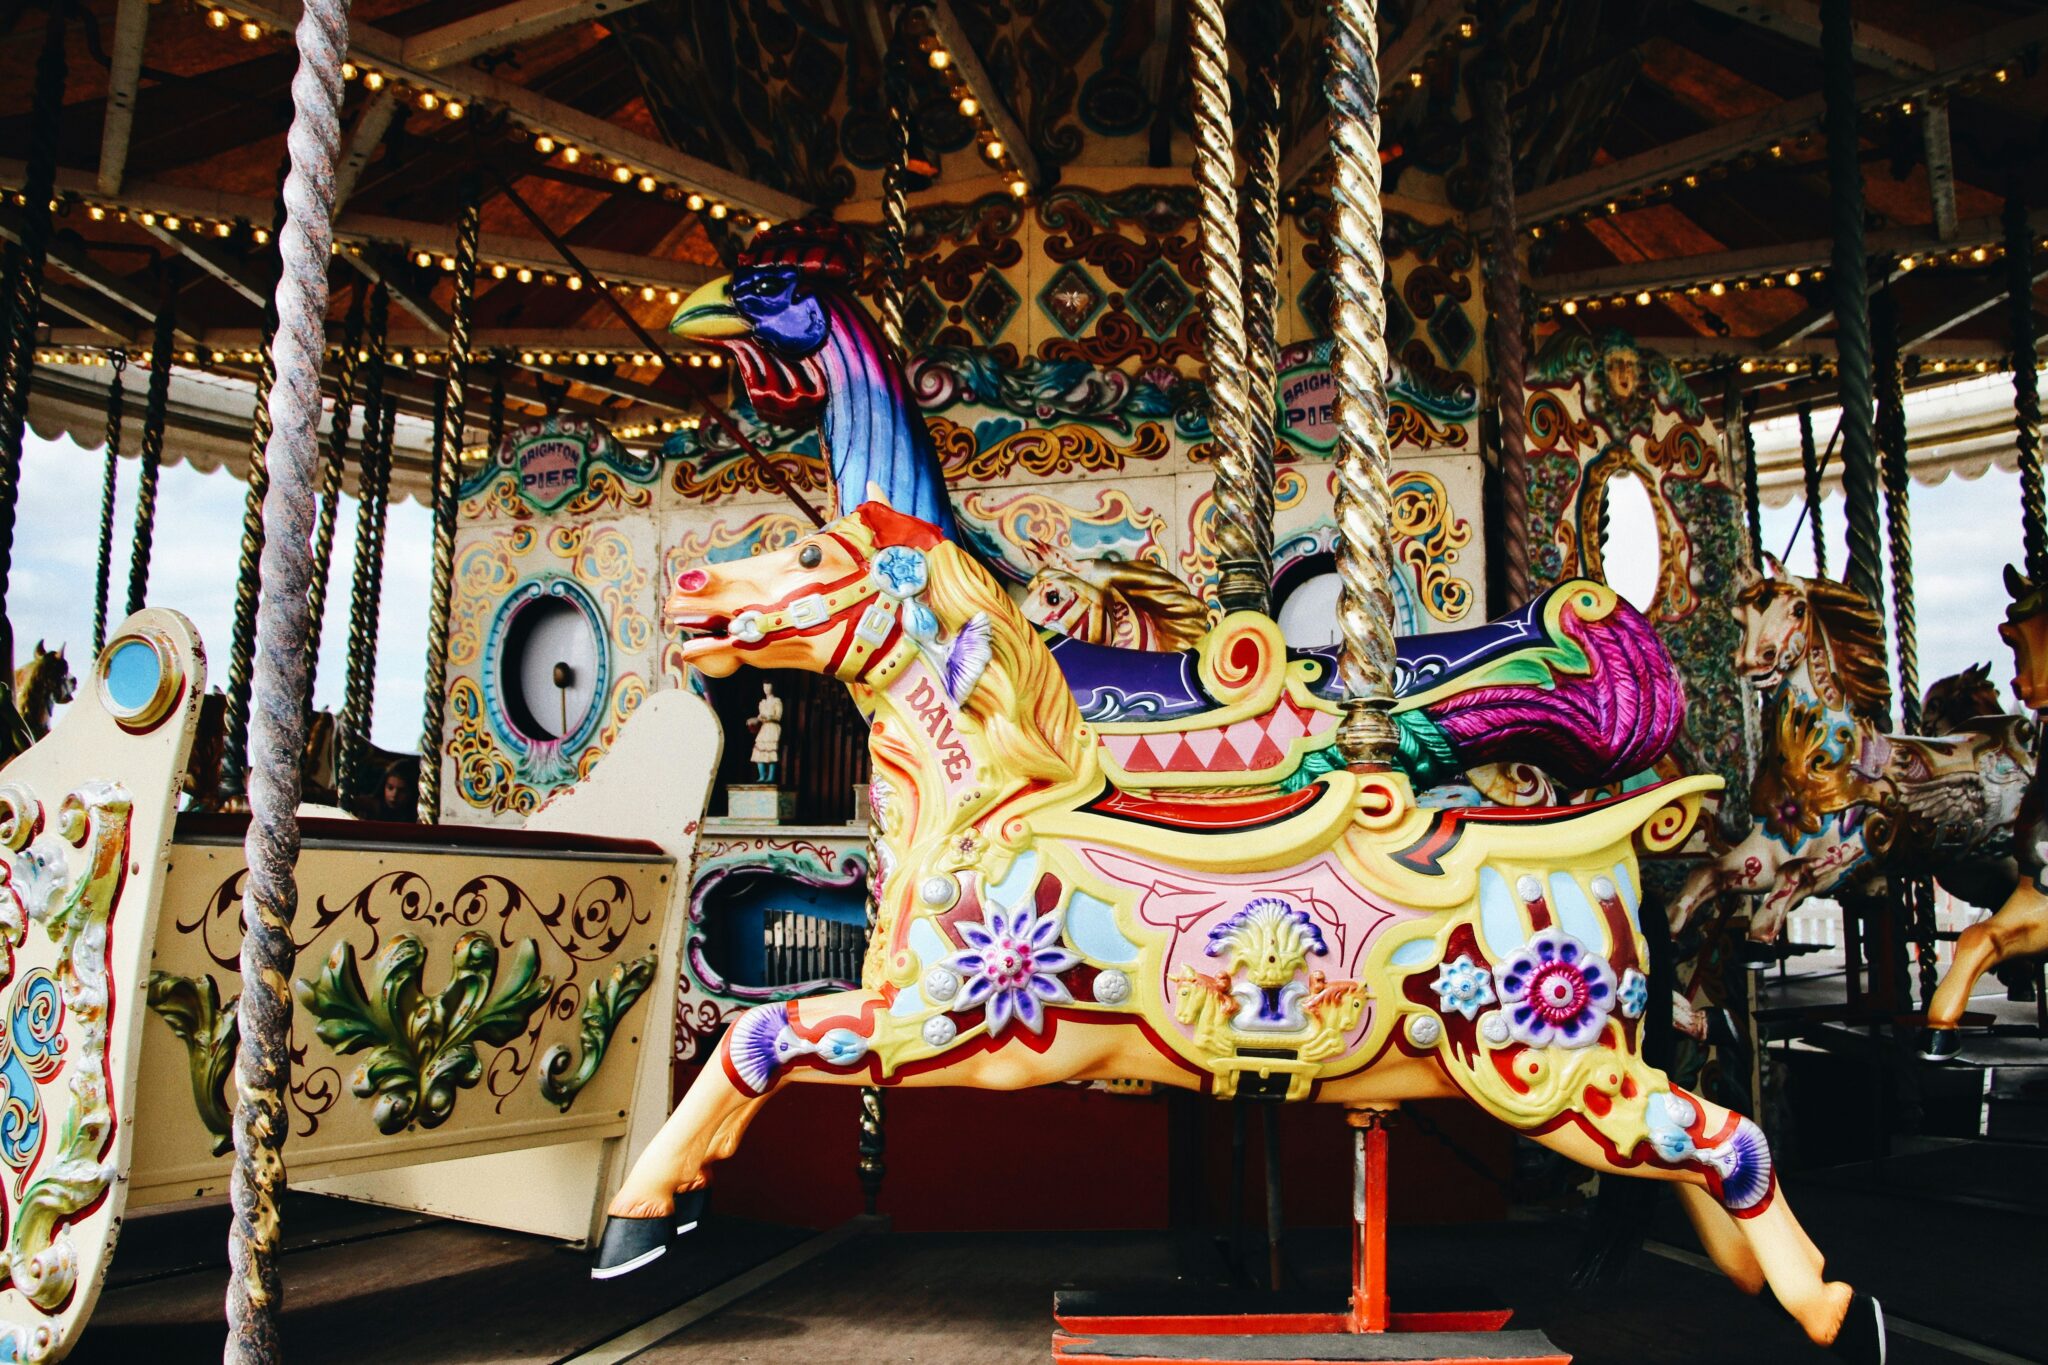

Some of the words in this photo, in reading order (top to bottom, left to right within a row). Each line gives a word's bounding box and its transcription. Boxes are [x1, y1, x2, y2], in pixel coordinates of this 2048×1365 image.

[1283, 373, 1338, 406] BRIGH
[1284, 404, 1334, 429] PIE
[520, 442, 580, 468] BRIGHTON
[521, 468, 578, 491] PIER
[905, 676, 972, 784] DAVE
